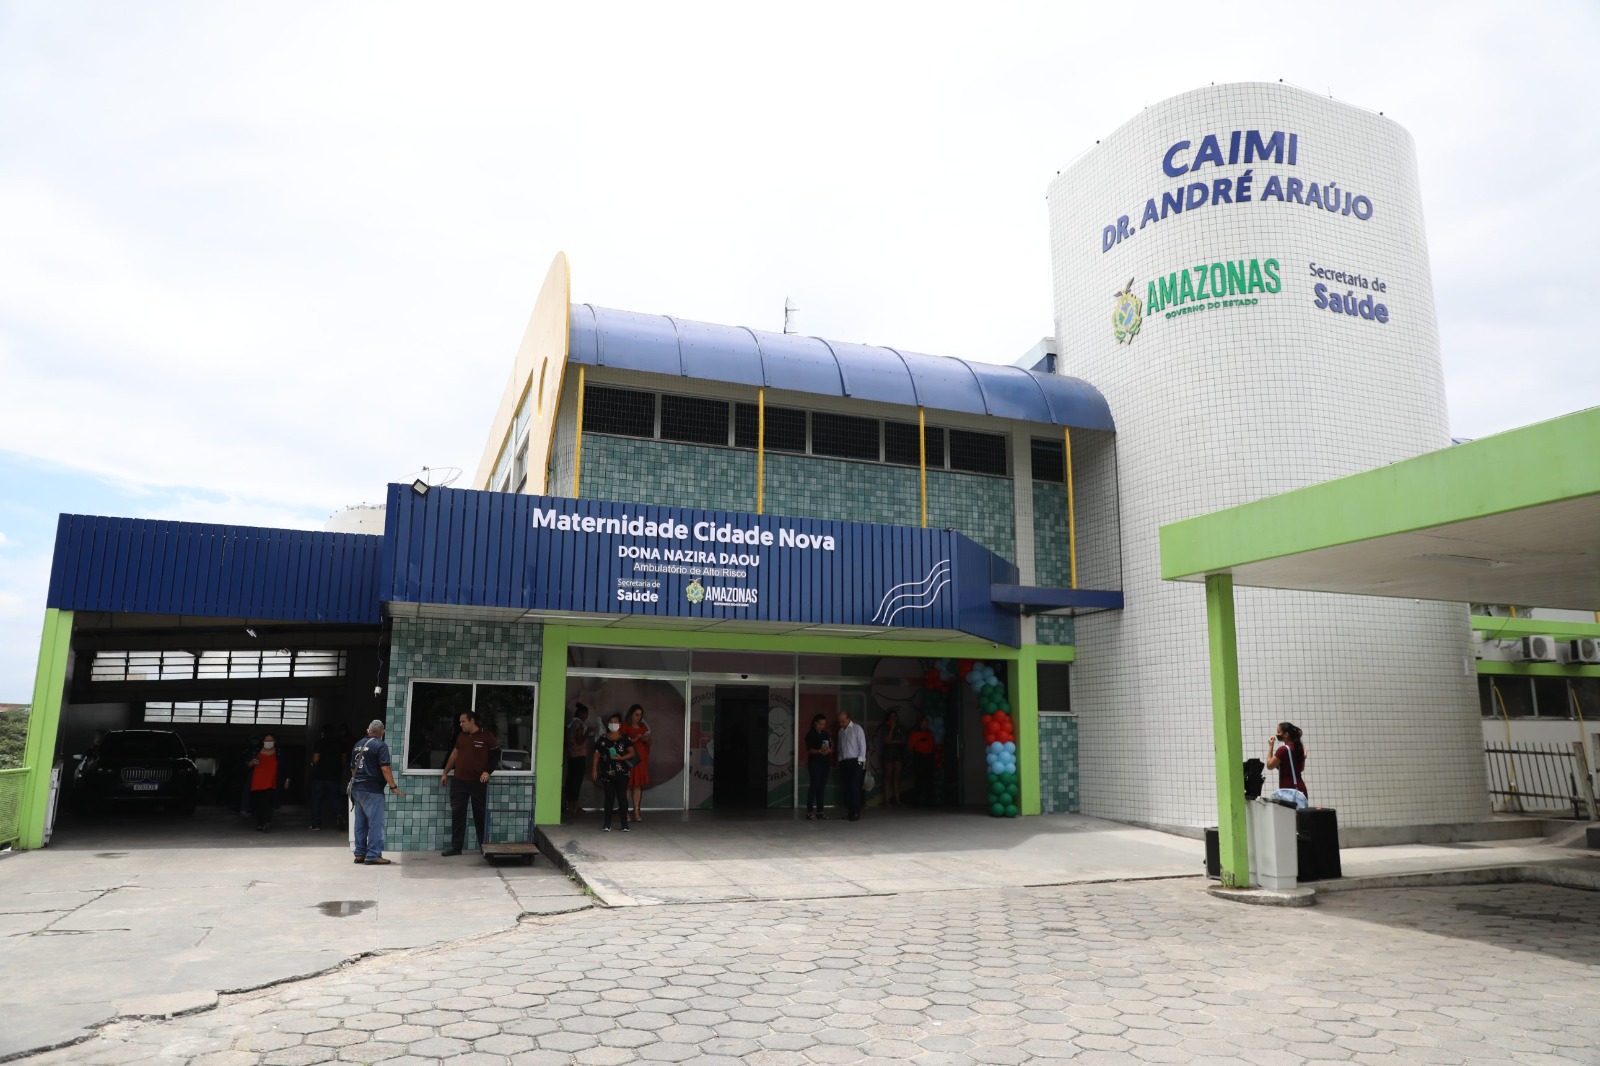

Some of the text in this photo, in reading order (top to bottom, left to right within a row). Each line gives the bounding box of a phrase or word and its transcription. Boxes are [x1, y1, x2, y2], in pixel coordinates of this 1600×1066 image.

[1162, 130, 1298, 177] CAIMI
[1102, 170, 1374, 253] DR. ANDRÉ ARAÚJO
[1146, 258, 1281, 316] AMAZONAS
[1309, 262, 1387, 293] Secretaria de
[1165, 297, 1259, 319] GOVERNO DO ESTADO
[1313, 283, 1390, 323] Saúde
[532, 508, 836, 551] Maternidade Cidade Nova
[618, 546, 760, 567] DONA NAZIRA DAOU
[617, 578, 650, 588] Secretaria
[633, 562, 747, 578] Ambulatório de Alto Risco
[617, 589, 659, 603] Saúde
[705, 586, 758, 603] AMAZONAS
